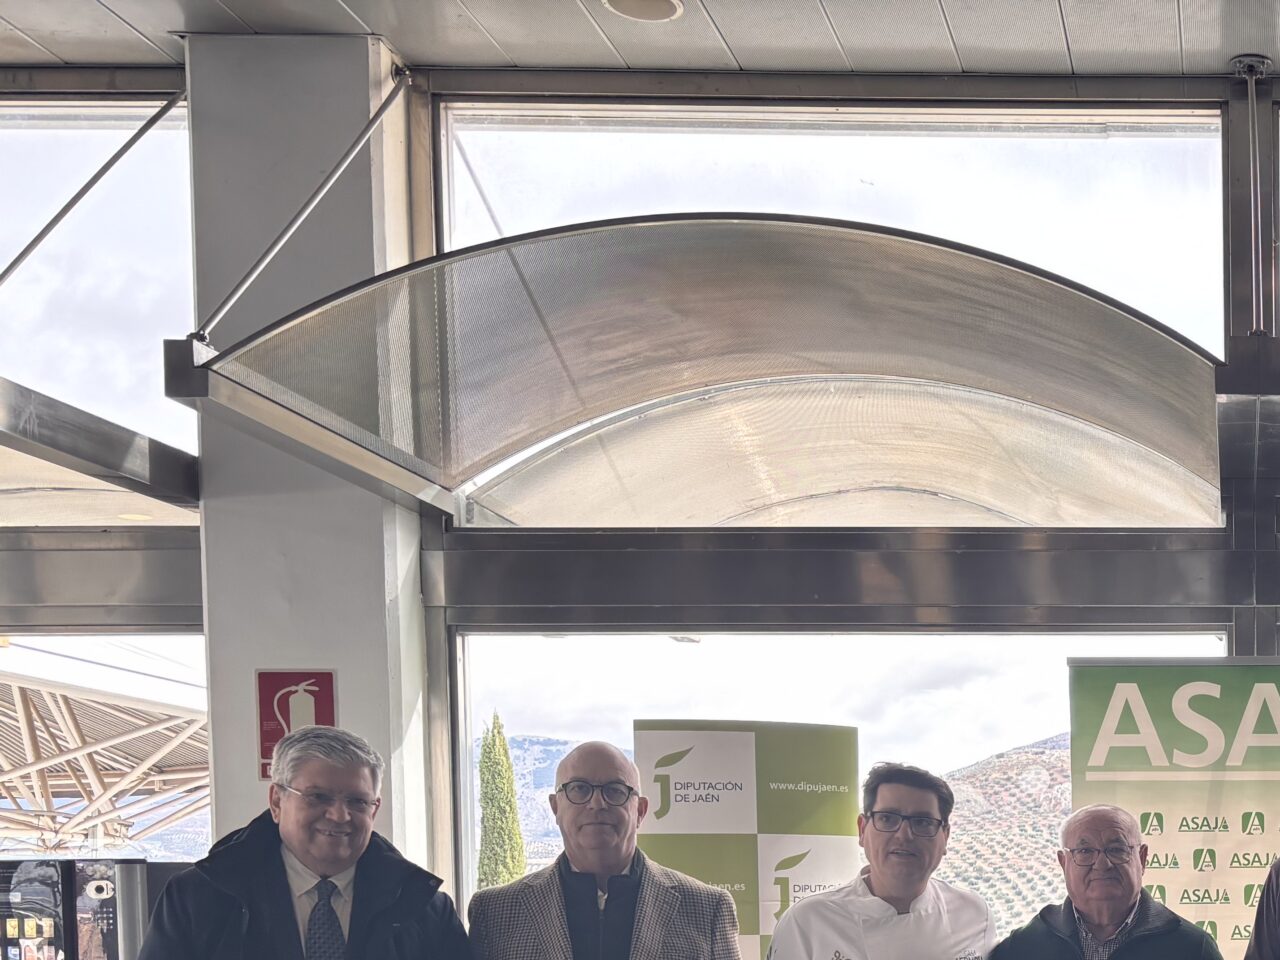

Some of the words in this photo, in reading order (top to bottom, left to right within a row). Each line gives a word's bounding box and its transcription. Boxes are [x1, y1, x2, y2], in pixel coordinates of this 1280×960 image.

[674, 780, 743, 791] DIPUTACIÓN
[769, 781, 849, 793] www.dipujaen.es
[674, 794, 690, 803] DE
[692, 792, 720, 803] JAÉN
[1179, 816, 1229, 832] ASAJA
[1180, 889, 1230, 904] ASAJA
